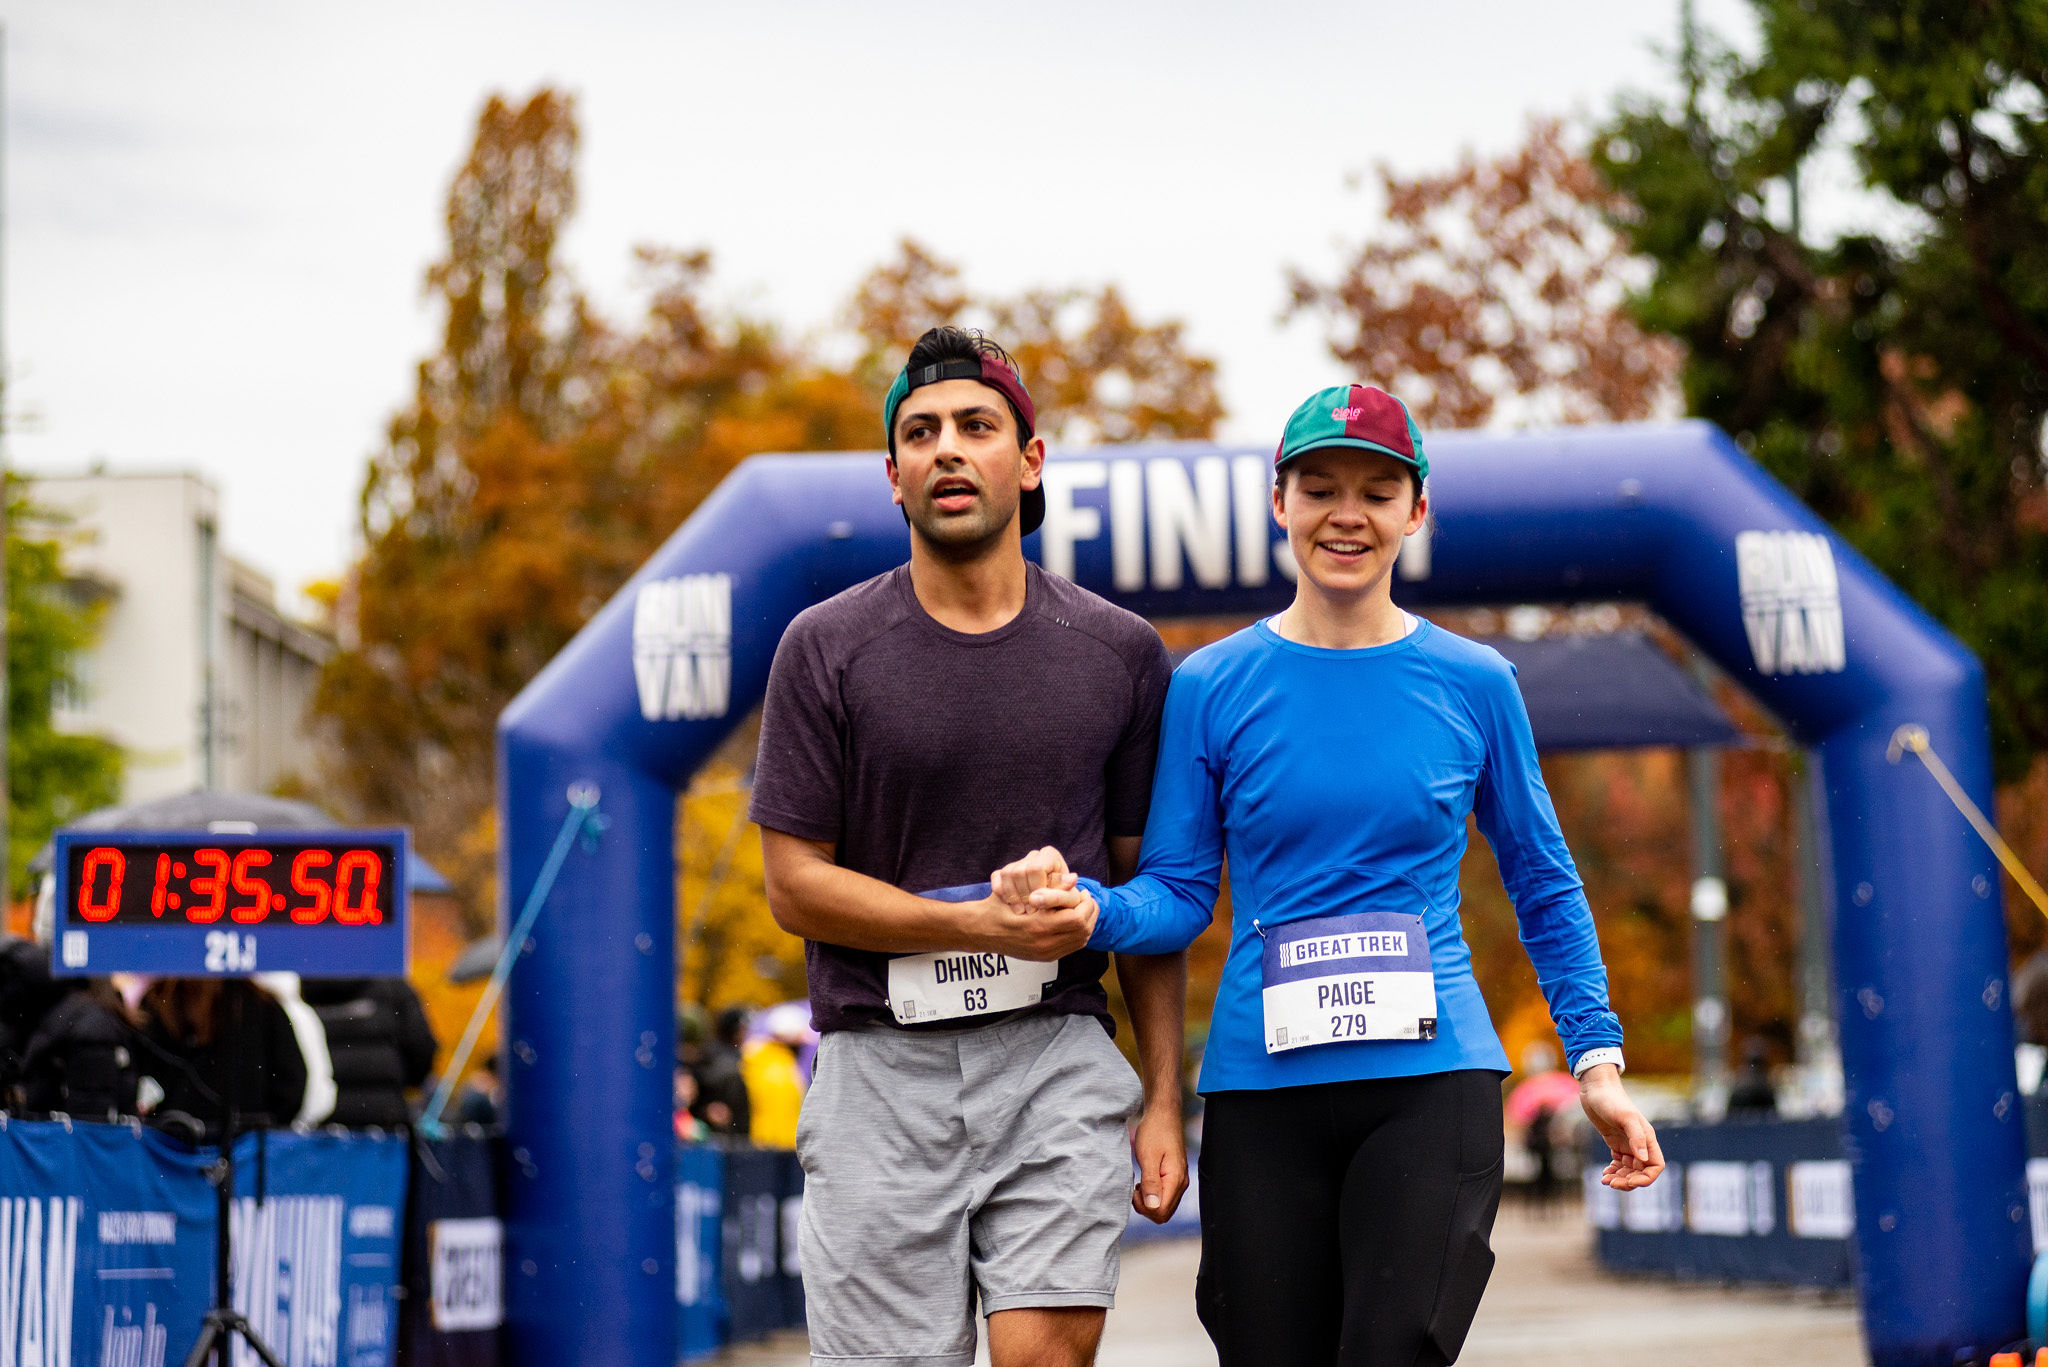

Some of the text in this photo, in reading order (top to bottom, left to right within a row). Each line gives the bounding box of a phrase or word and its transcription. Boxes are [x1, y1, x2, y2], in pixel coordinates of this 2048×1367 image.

[1041, 454, 1433, 592] FINI
[1741, 601, 1847, 676] VAN
[633, 647, 732, 722] VAN
[1296, 935, 1403, 960] GREAT TREK
[934, 953, 1010, 984] DHINSA
[963, 987, 988, 1012] 63
[1317, 980, 1376, 1009] PAIGE
[1331, 1013, 1367, 1038] 279
